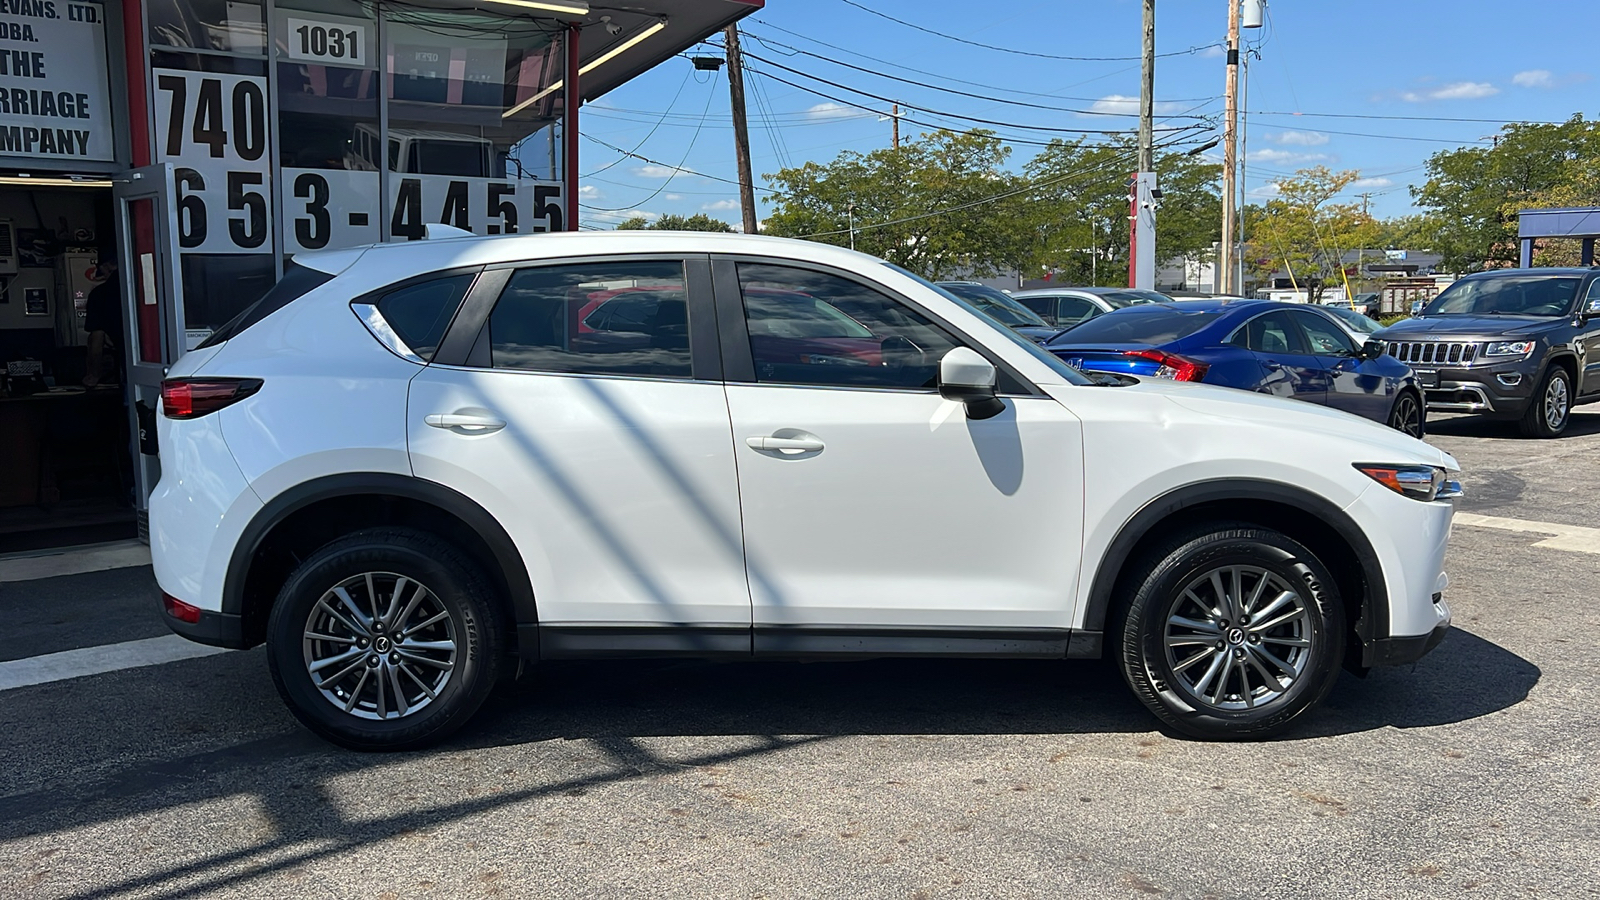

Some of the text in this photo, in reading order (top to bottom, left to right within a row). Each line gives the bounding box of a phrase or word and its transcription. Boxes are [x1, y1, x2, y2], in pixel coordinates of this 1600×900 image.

[0, 0, 101, 24] EVANS. LTD.
[0, 22, 38, 42] DBA.
[297, 25, 357, 59] 1031
[0, 49, 46, 78] THE
[158, 75, 265, 161] 740
